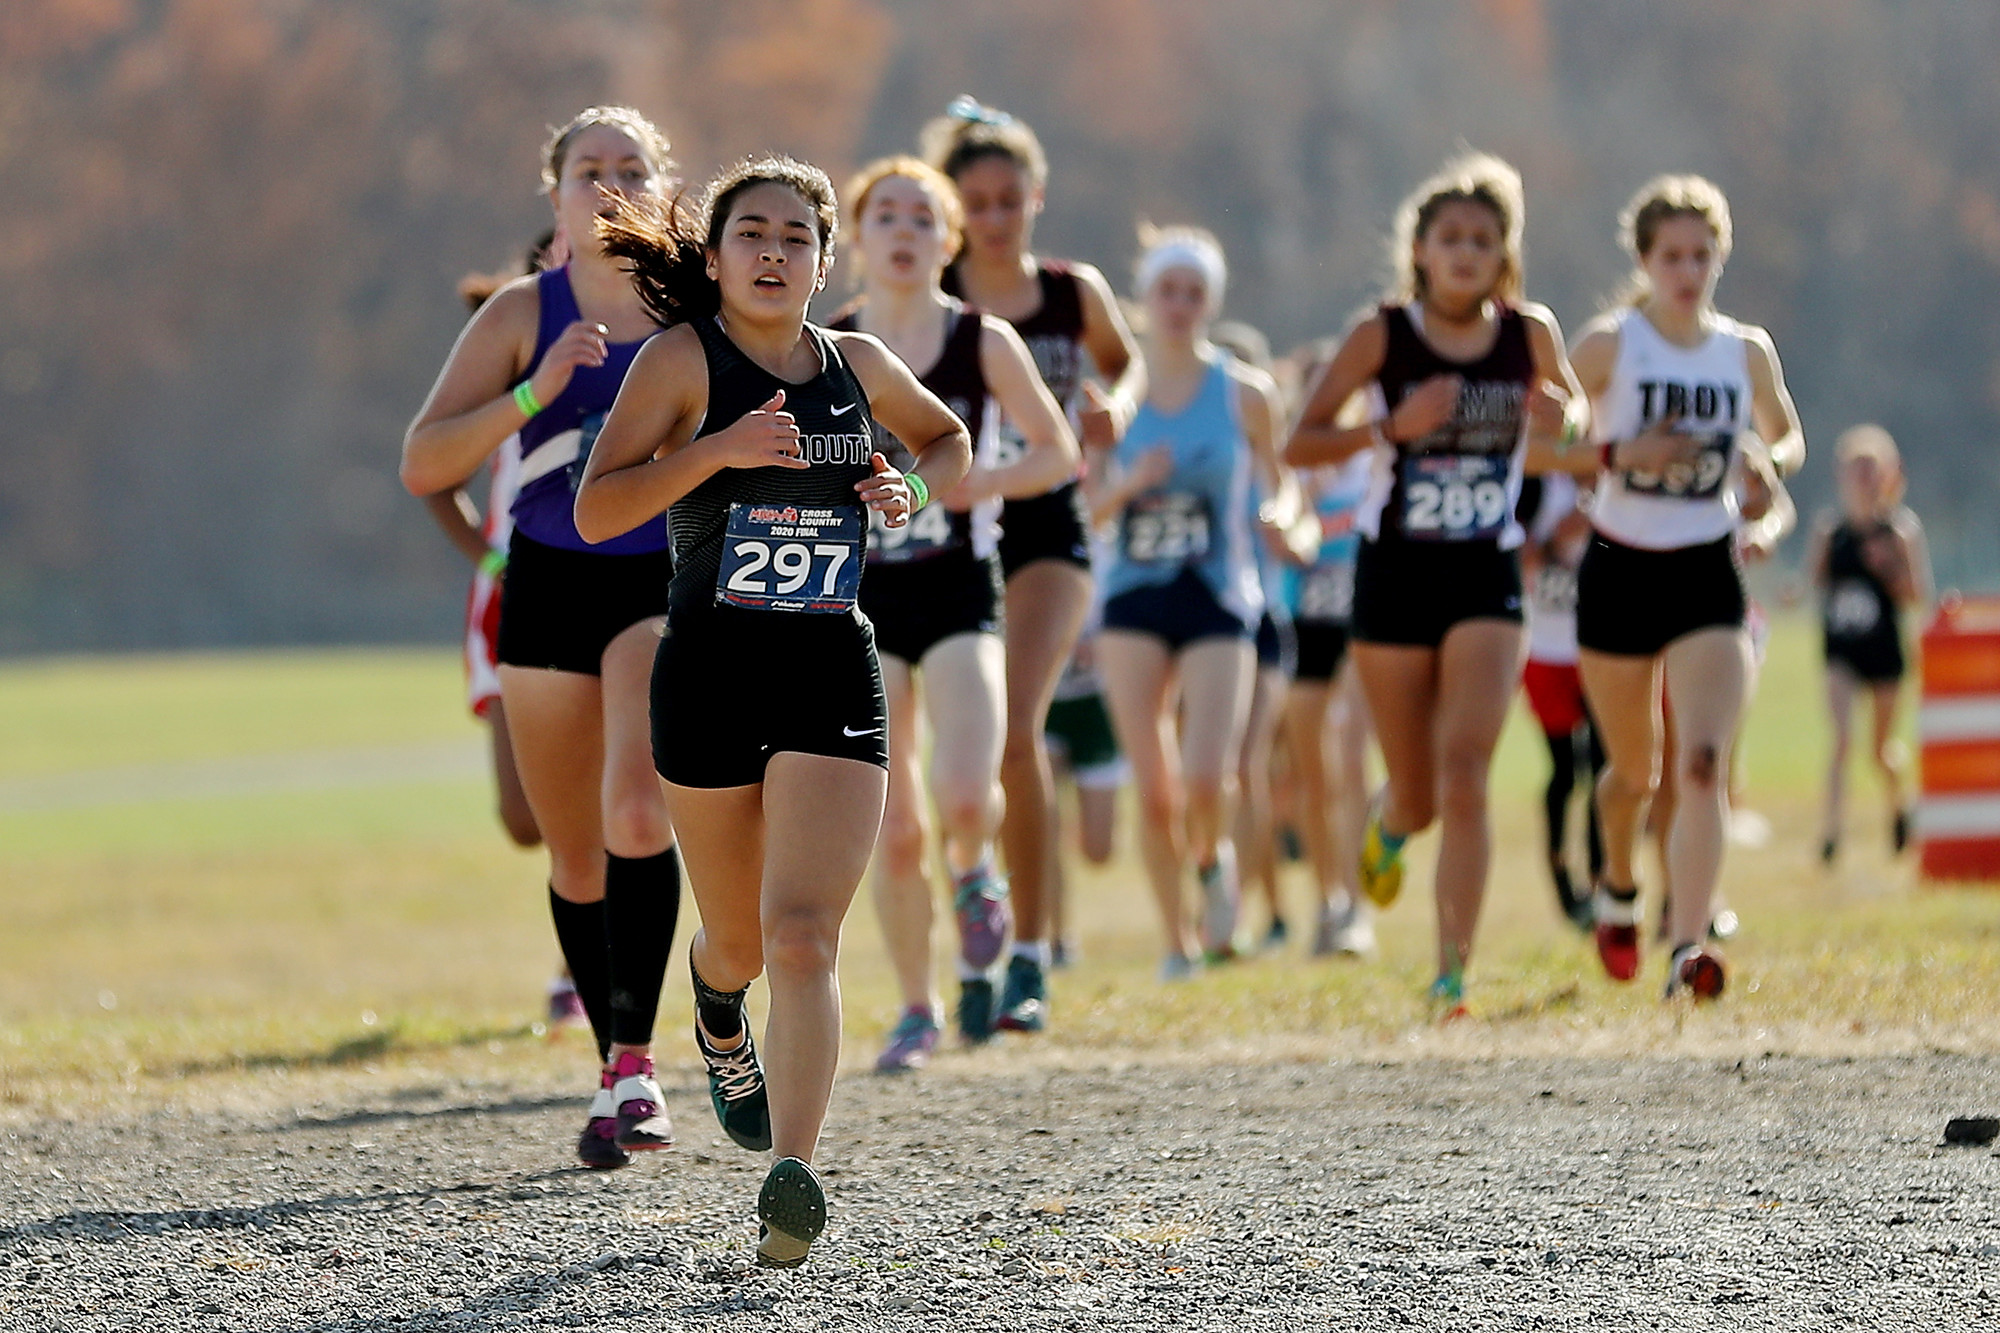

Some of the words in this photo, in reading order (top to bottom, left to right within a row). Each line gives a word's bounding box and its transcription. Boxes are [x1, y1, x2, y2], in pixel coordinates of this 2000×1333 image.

[1638, 378, 1740, 421] TROY
[801, 509, 833, 518] CROSS
[1405, 480, 1506, 529] 289
[770, 526, 794, 537] 2020
[795, 527, 819, 537] FINAL
[800, 518, 843, 527] COUNTRY
[727, 541, 850, 595] 297
